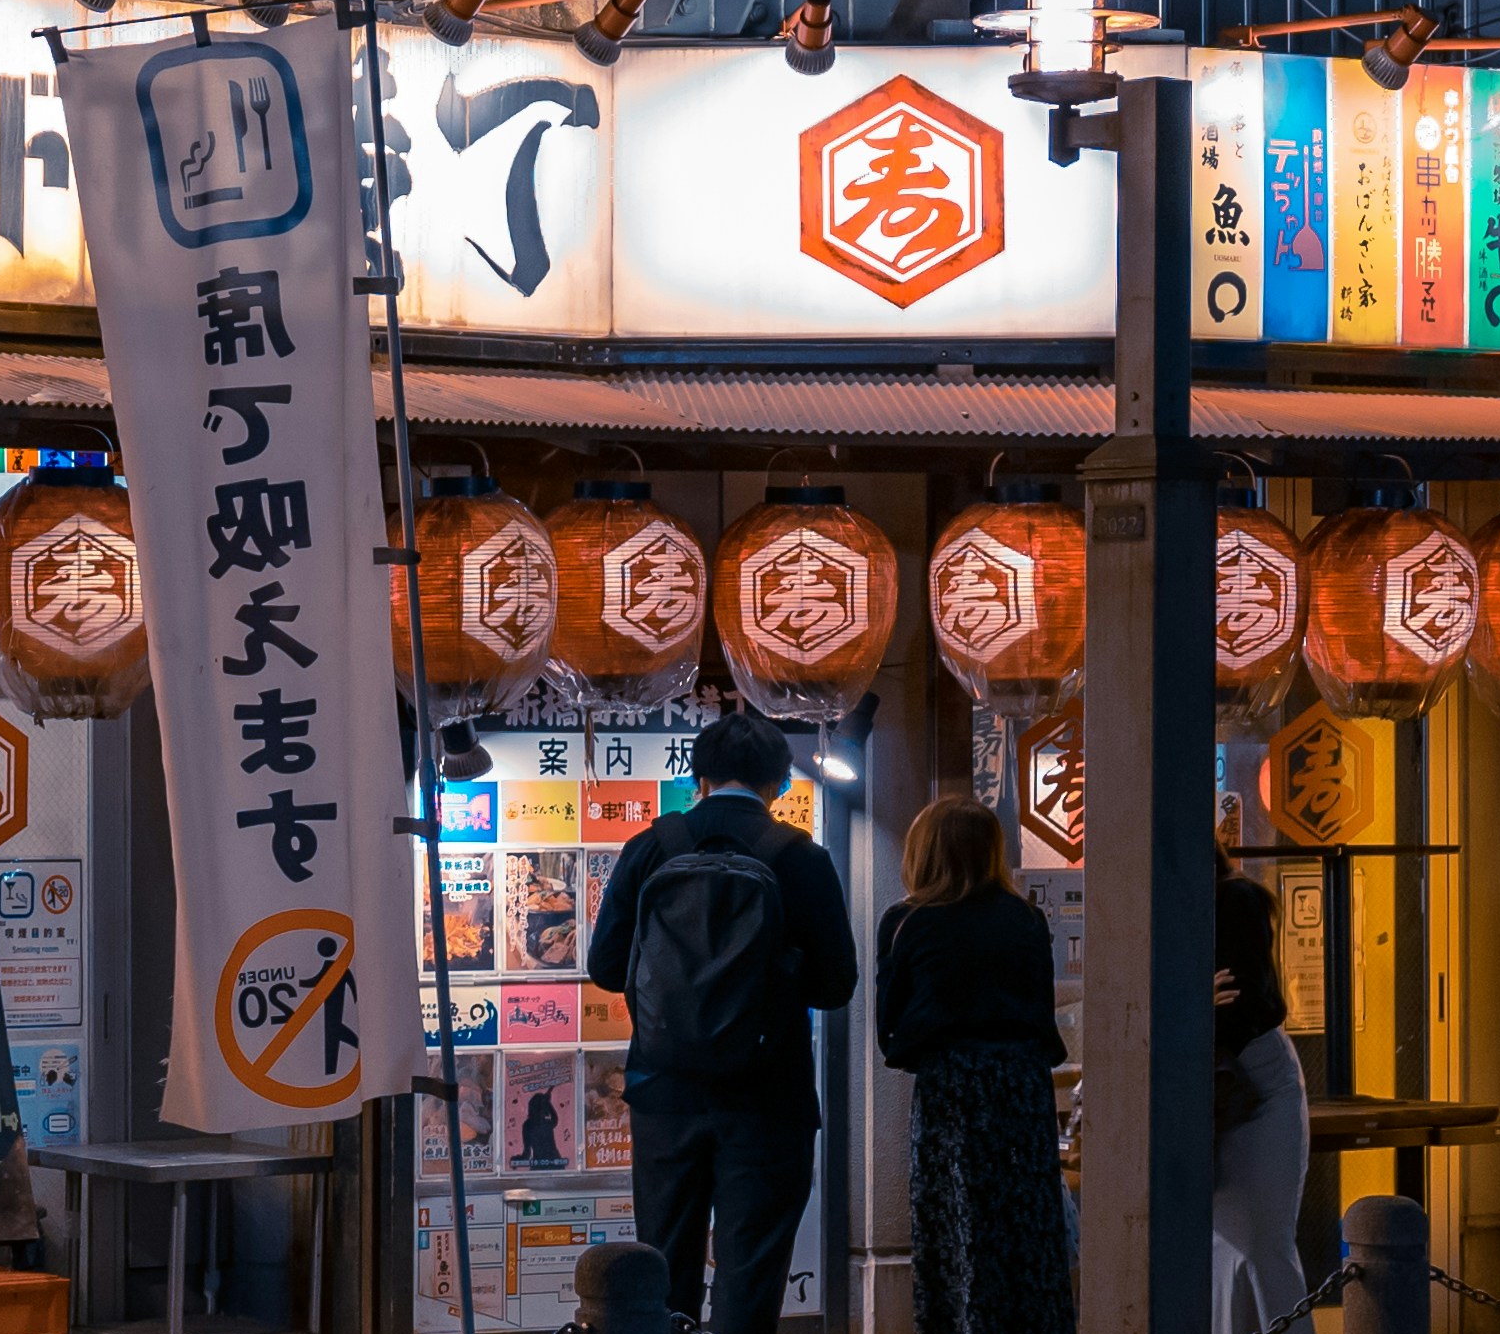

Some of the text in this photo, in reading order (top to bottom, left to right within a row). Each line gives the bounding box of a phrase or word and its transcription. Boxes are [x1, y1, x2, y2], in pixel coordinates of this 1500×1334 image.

[1355, 162, 1378, 309] おばんざい家
